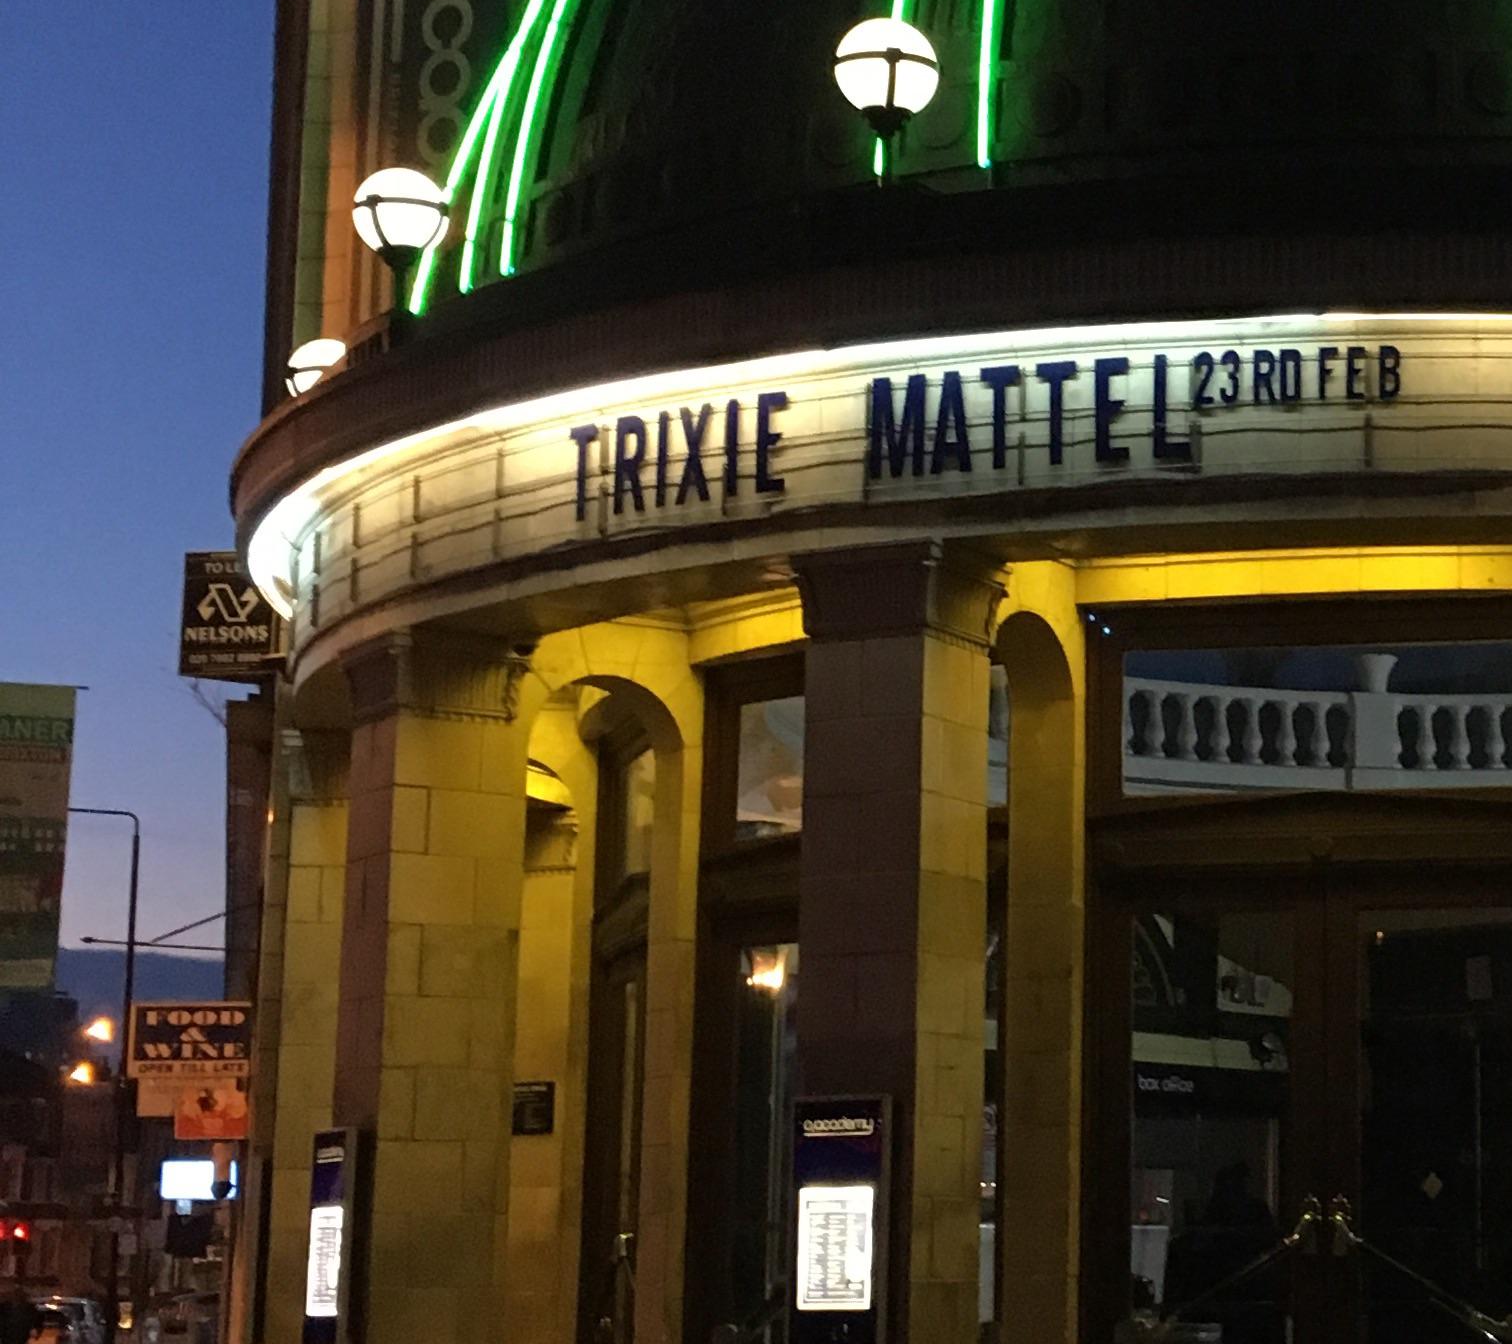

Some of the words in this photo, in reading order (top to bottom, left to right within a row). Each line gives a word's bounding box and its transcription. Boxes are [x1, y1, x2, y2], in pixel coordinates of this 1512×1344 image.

[569, 390, 788, 523] TRIXIE
[866, 353, 1195, 480] MATTEL
[1318, 345, 1402, 400] FEB
[184, 624, 269, 644] NELSONS
[145, 1010, 246, 1027] FOOD
[179, 1026, 207, 1042] &
[143, 1042, 245, 1058] WINE
[138, 1063, 174, 1074] OPEN
[180, 1063, 206, 1074] TILL
[213, 1063, 246, 1073] LATE
